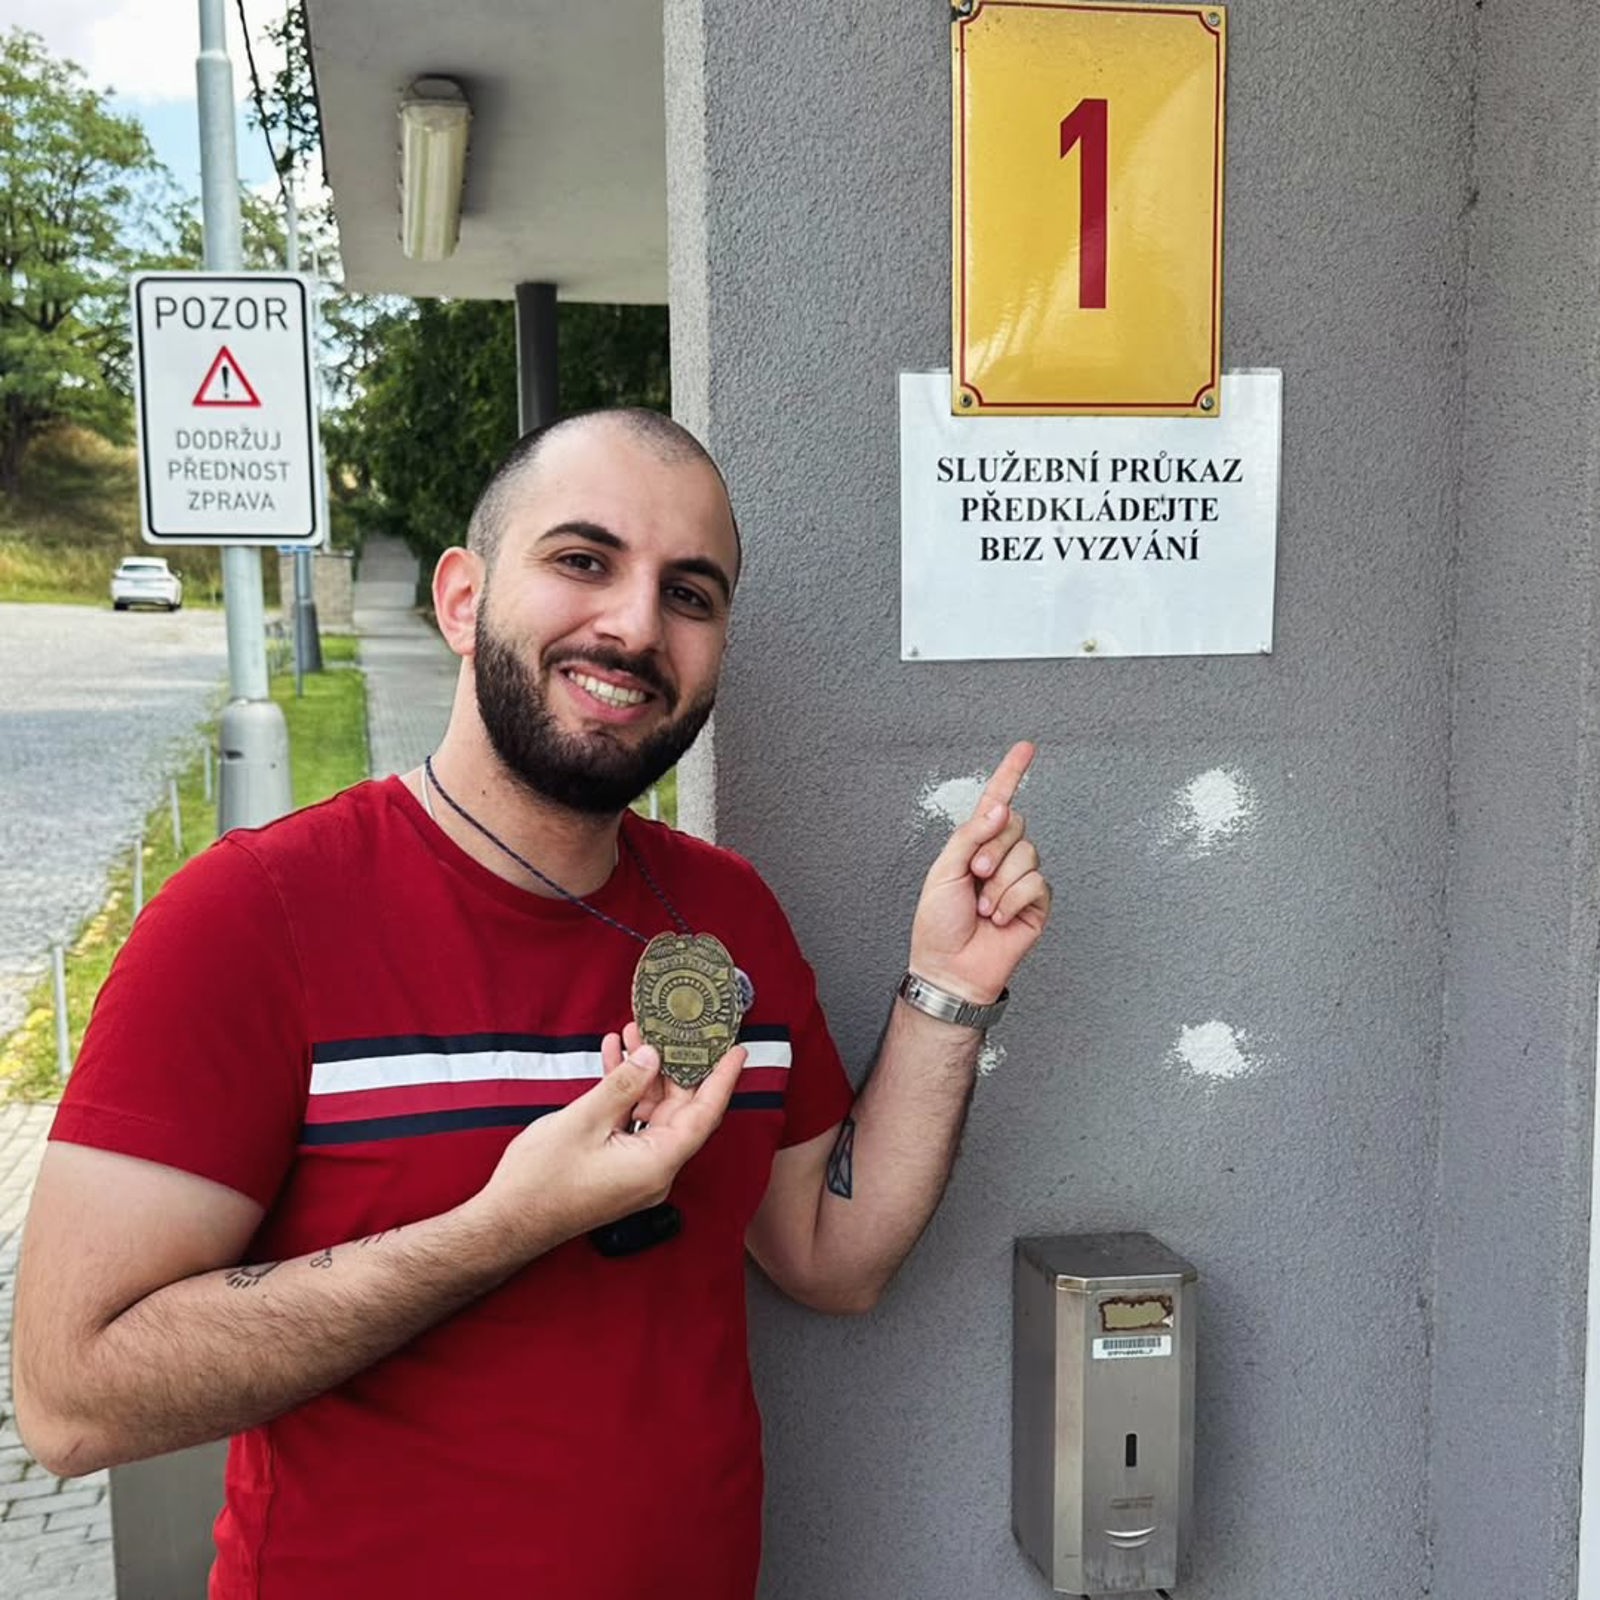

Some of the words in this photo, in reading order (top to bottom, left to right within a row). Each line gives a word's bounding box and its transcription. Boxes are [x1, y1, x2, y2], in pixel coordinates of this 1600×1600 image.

[1059, 98, 1107, 309] 1
[155, 296, 288, 330] POZOR
[176, 425, 282, 450] DODRŽUJ
[168, 456, 290, 481] PŘEDNOST
[937, 450, 1100, 483] SLUŽEBNÍ
[1110, 450, 1244, 483] PRŮKAZ
[187, 491, 276, 512] ZPRAVA
[961, 490, 1219, 523] PŘEDKLÁDEJTE
[979, 536, 1043, 562] BEZ
[1054, 529, 1200, 562] VYZVÁNÍ
